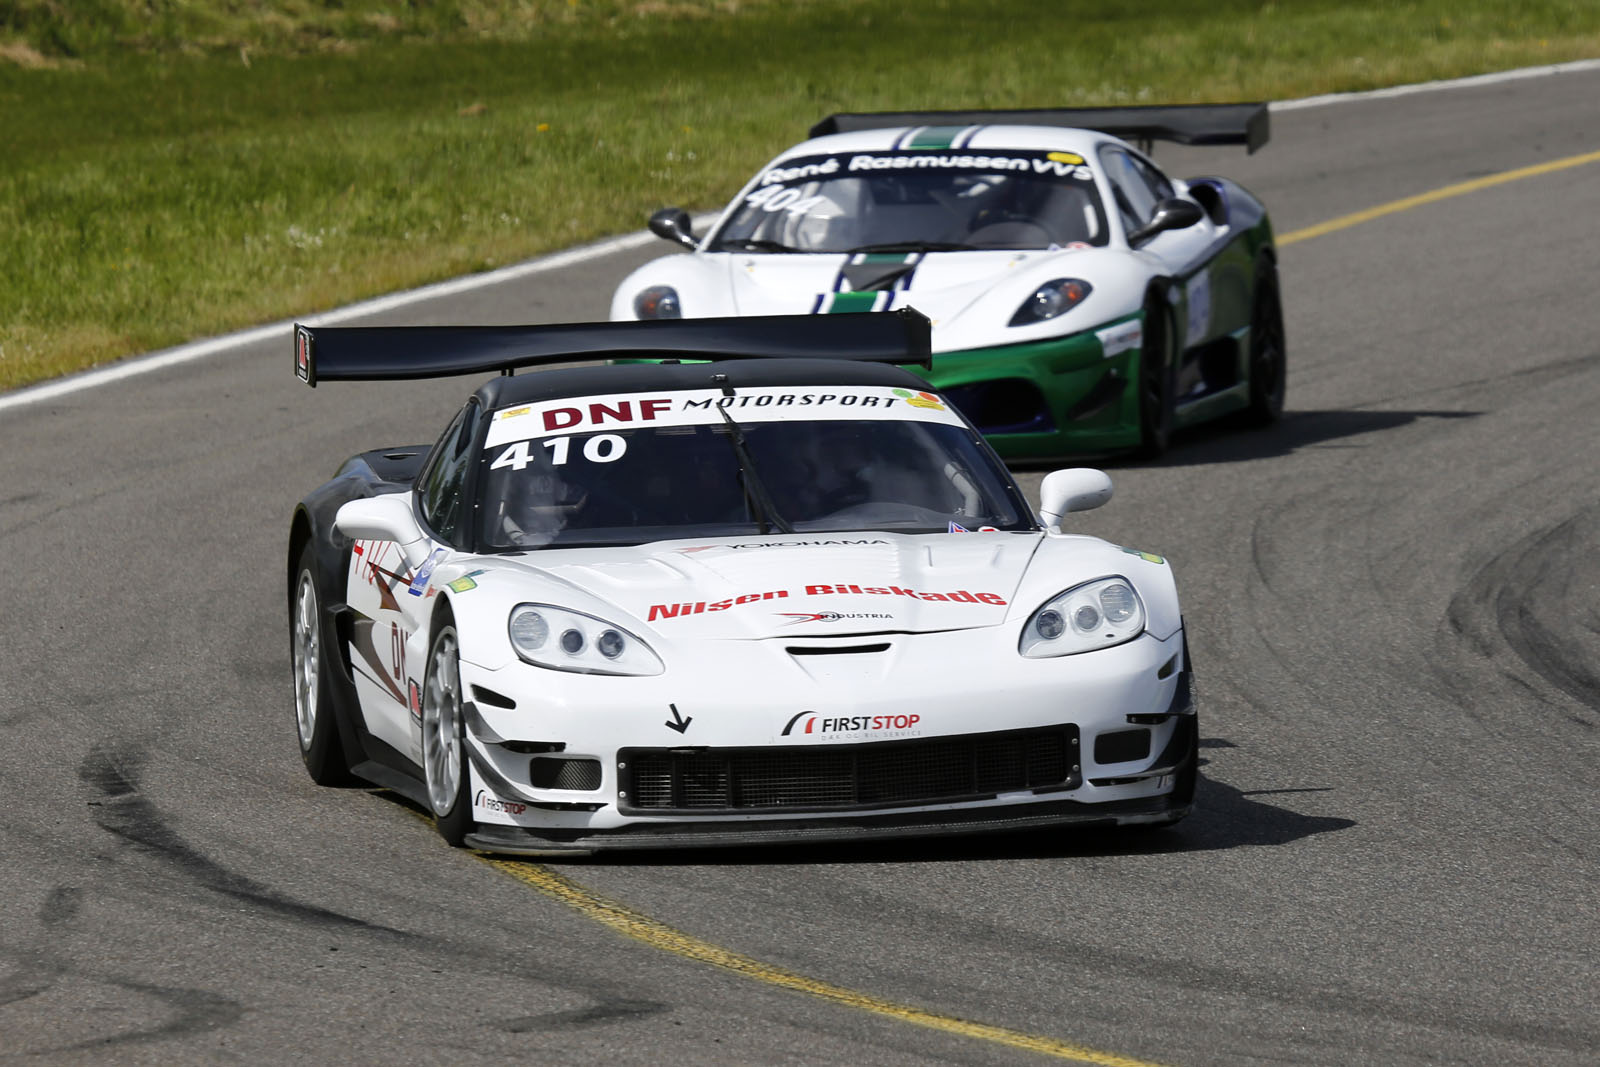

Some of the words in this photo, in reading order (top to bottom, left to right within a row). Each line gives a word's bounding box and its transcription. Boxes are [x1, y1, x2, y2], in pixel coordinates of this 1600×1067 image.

[761, 158, 840, 186] René
[848, 155, 1030, 171] Rasmussen
[1032, 159, 1093, 180] VVS
[746, 184, 828, 217] 404
[542, 399, 672, 431] DNF
[682, 394, 900, 410] MOTORSPORT
[490, 434, 627, 470] 410
[725, 540, 890, 549] YOKOHAMA
[647, 589, 789, 622] Nilsen
[805, 584, 1008, 606] Bilskade
[822, 714, 921, 733] FIRSTSTOP
[487, 799, 527, 815] FIRSTSTOP
